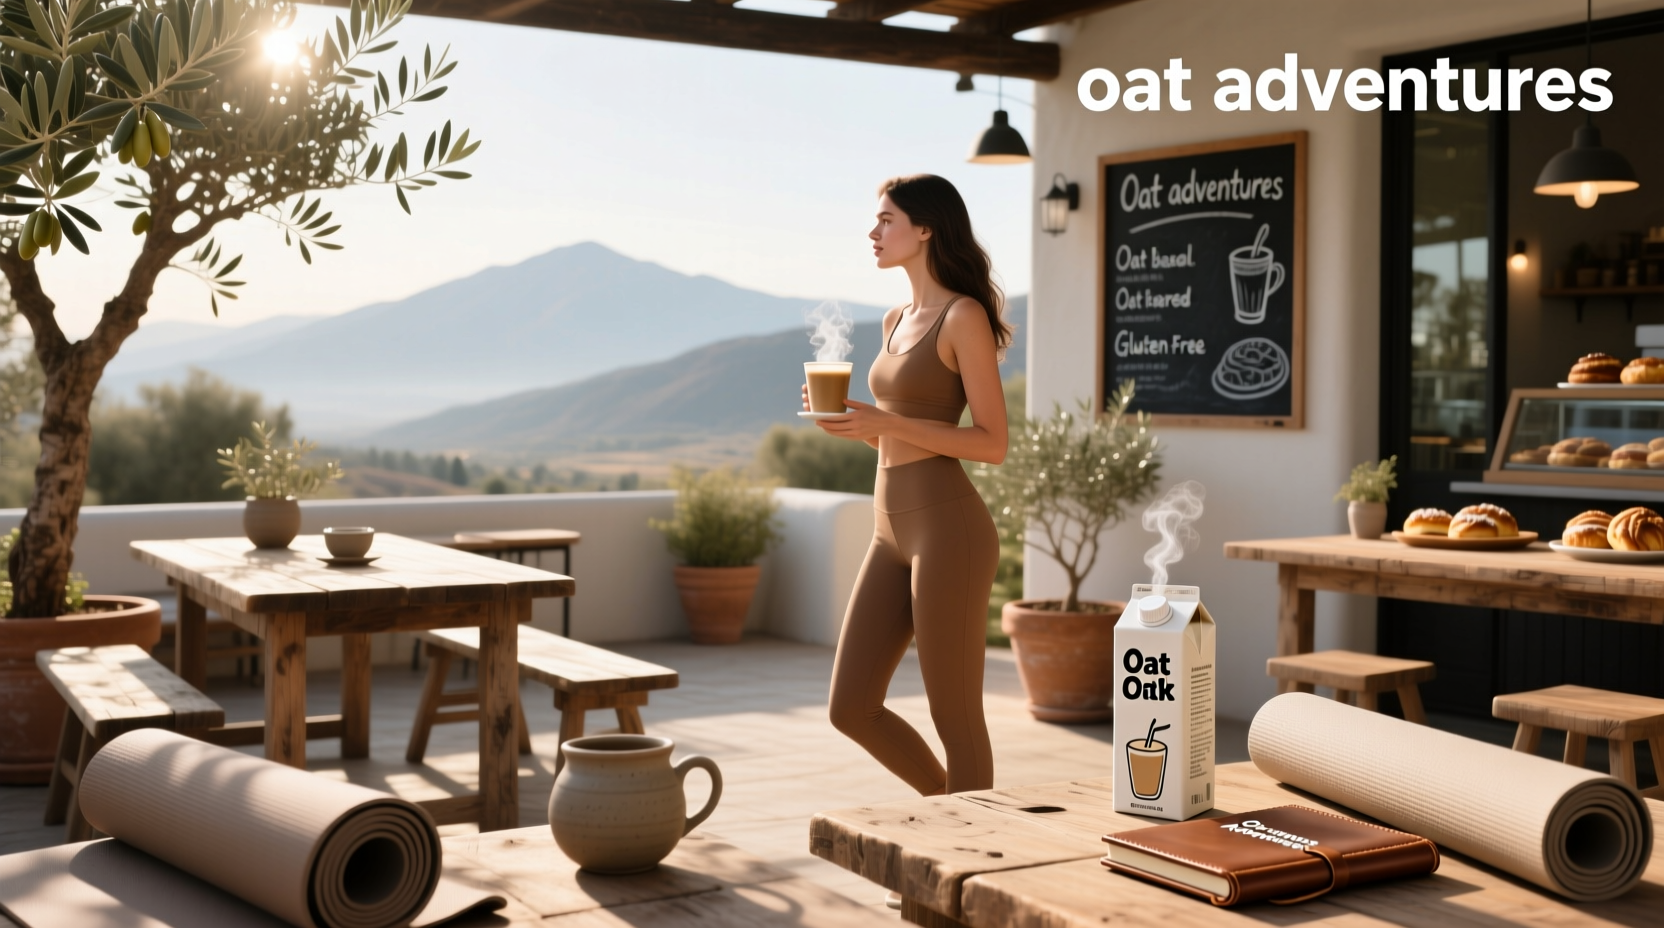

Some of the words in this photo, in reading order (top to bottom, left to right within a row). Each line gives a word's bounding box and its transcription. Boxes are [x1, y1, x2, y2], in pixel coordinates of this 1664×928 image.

[1121, 174, 1162, 212] Oat
[1168, 169, 1282, 205] adventures
[1116, 245, 1147, 271] Oat
[1116, 287, 1142, 310] Oat
[1115, 330, 1168, 357] Gluten
[1171, 335, 1205, 354] Free
[1123, 649, 1170, 675] Oat
